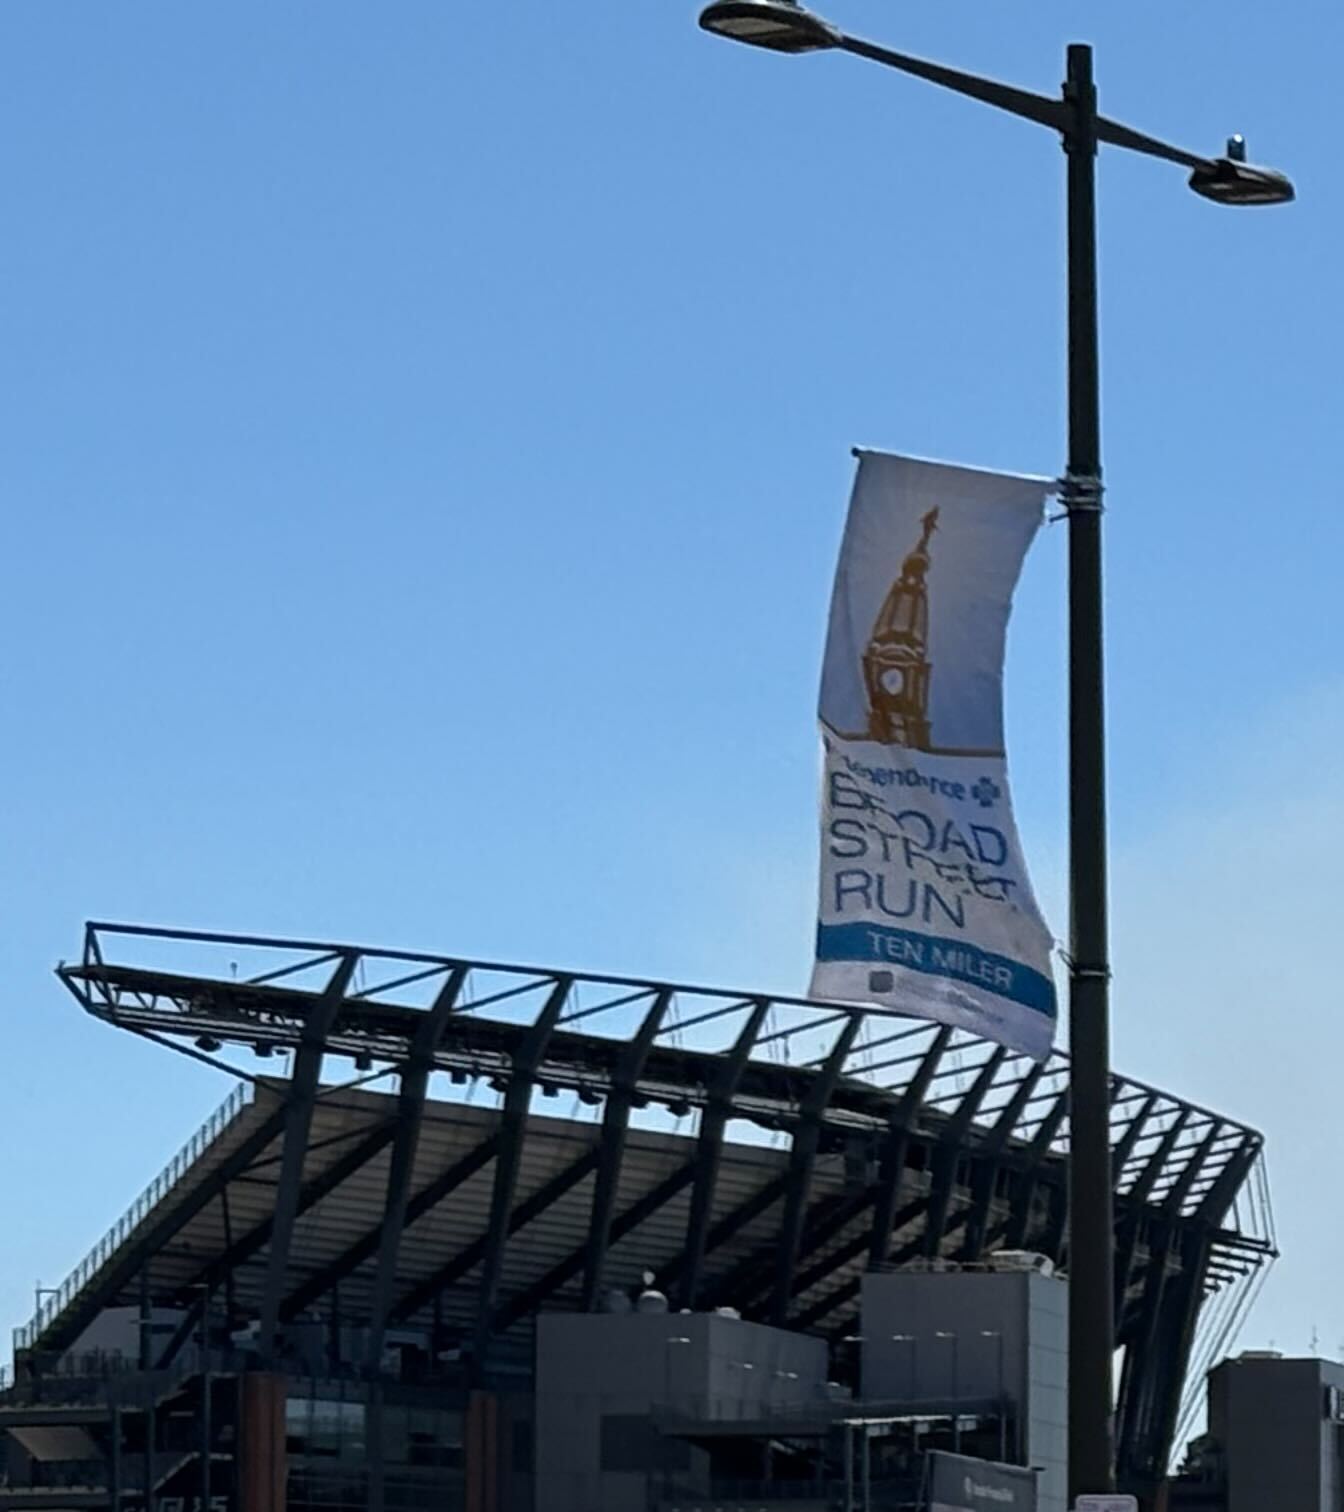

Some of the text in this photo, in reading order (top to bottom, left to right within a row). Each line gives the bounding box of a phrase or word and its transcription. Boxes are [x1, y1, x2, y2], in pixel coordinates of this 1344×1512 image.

[834, 869, 966, 930] RUN
[867, 930, 1013, 992] TEN MILER
